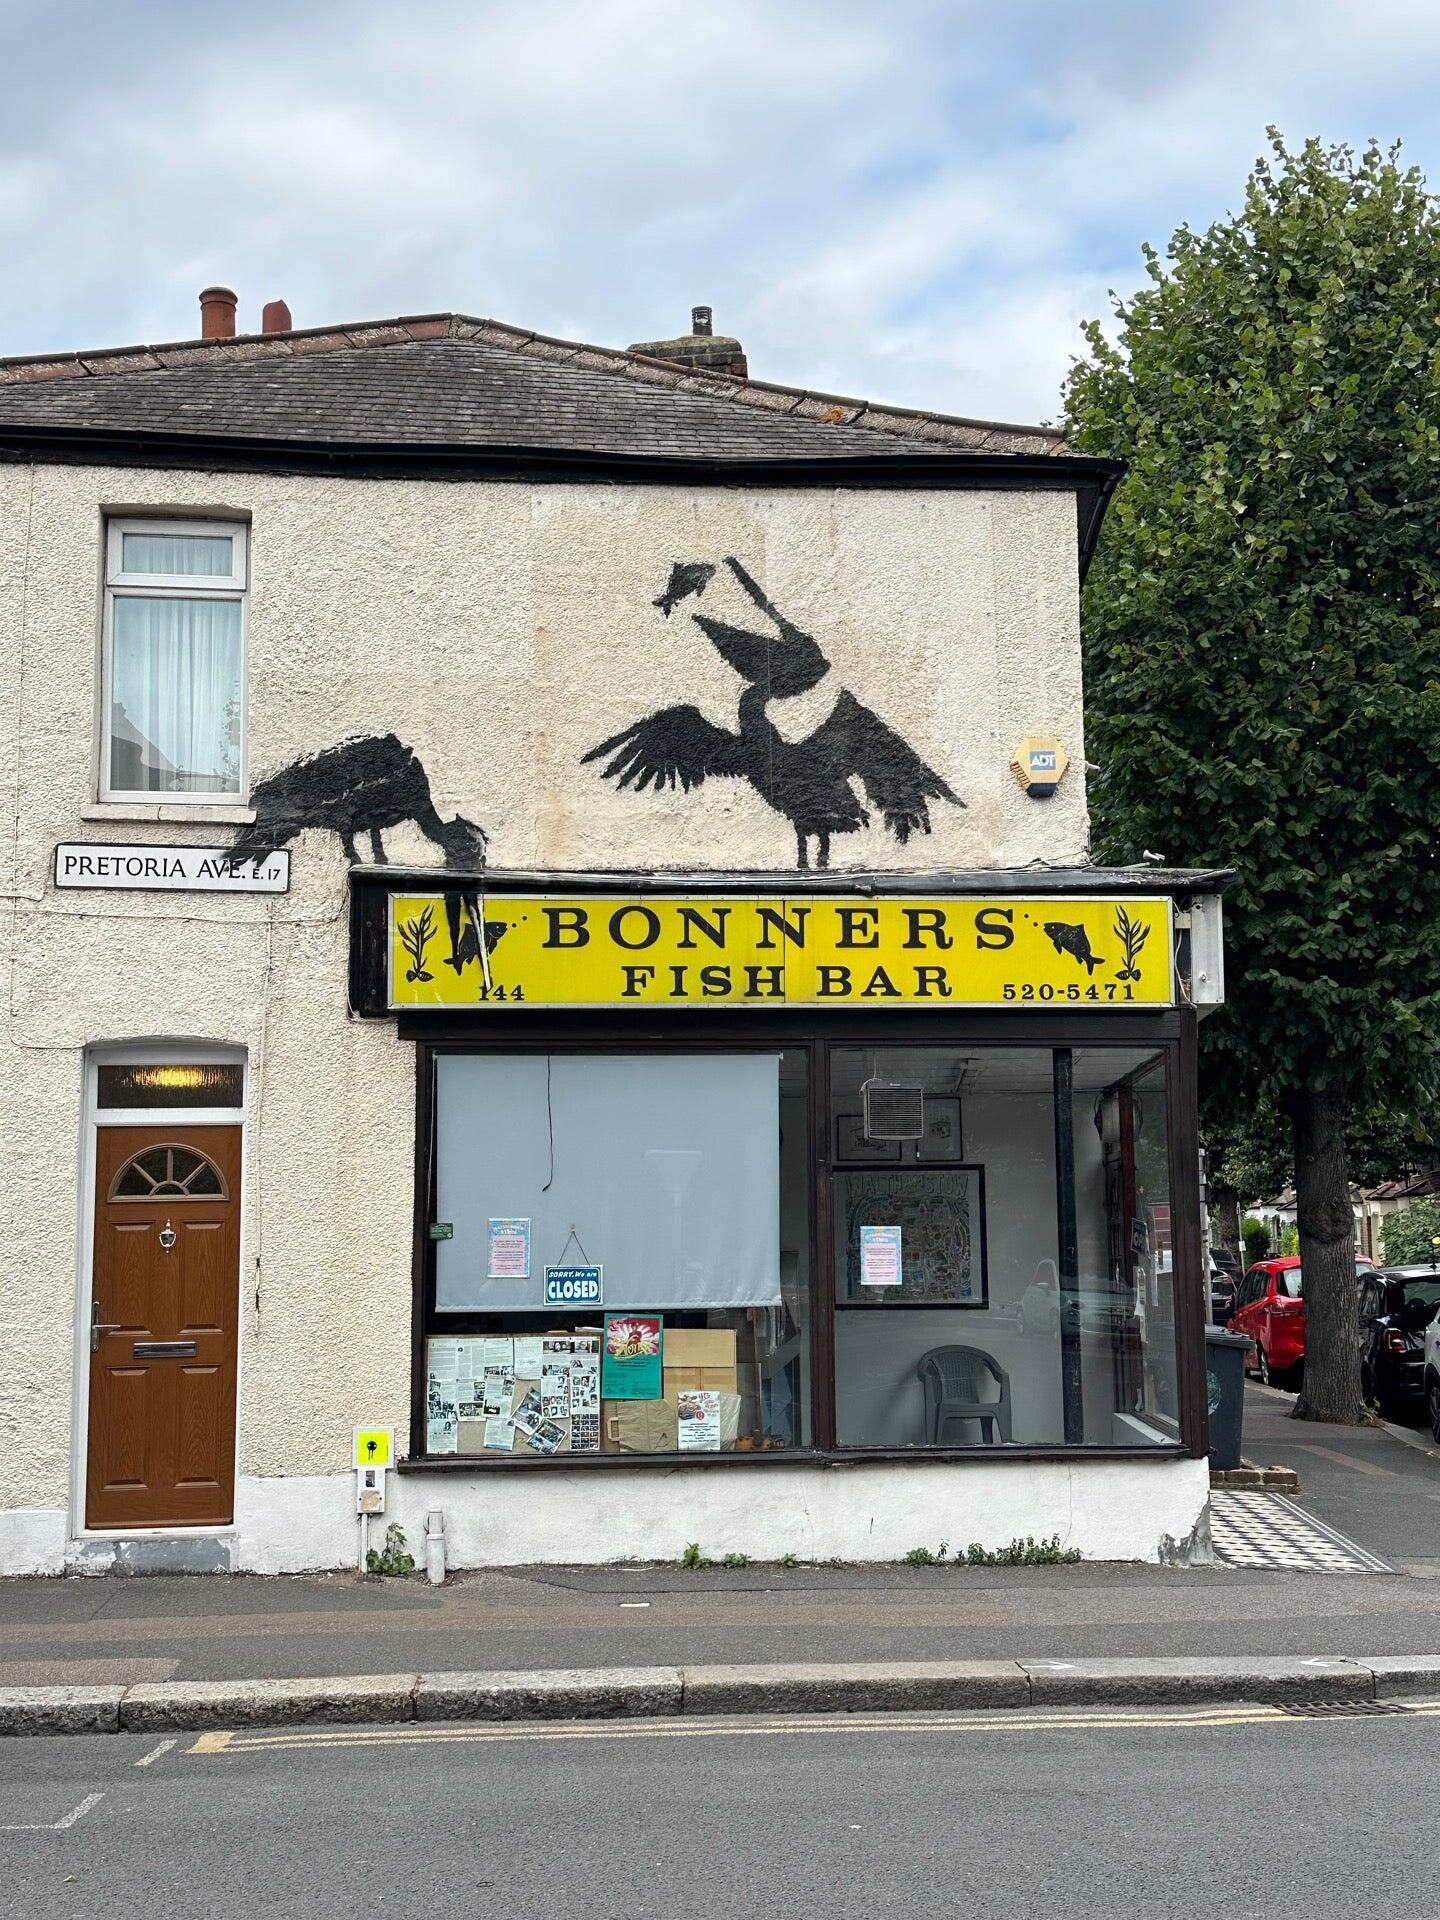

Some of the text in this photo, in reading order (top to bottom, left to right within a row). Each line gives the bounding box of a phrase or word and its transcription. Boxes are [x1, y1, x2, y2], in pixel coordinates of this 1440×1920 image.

[1030, 754, 1056, 767] ADT
[64, 855, 281, 881] PRETORIA AVE. E. 17
[541, 906, 1015, 951] BONNERS
[621, 965, 953, 997] FISH BAR
[478, 984, 525, 1001] 144
[1002, 983, 1135, 1001] 520-5471
[548, 1280, 598, 1299] CLOSED
